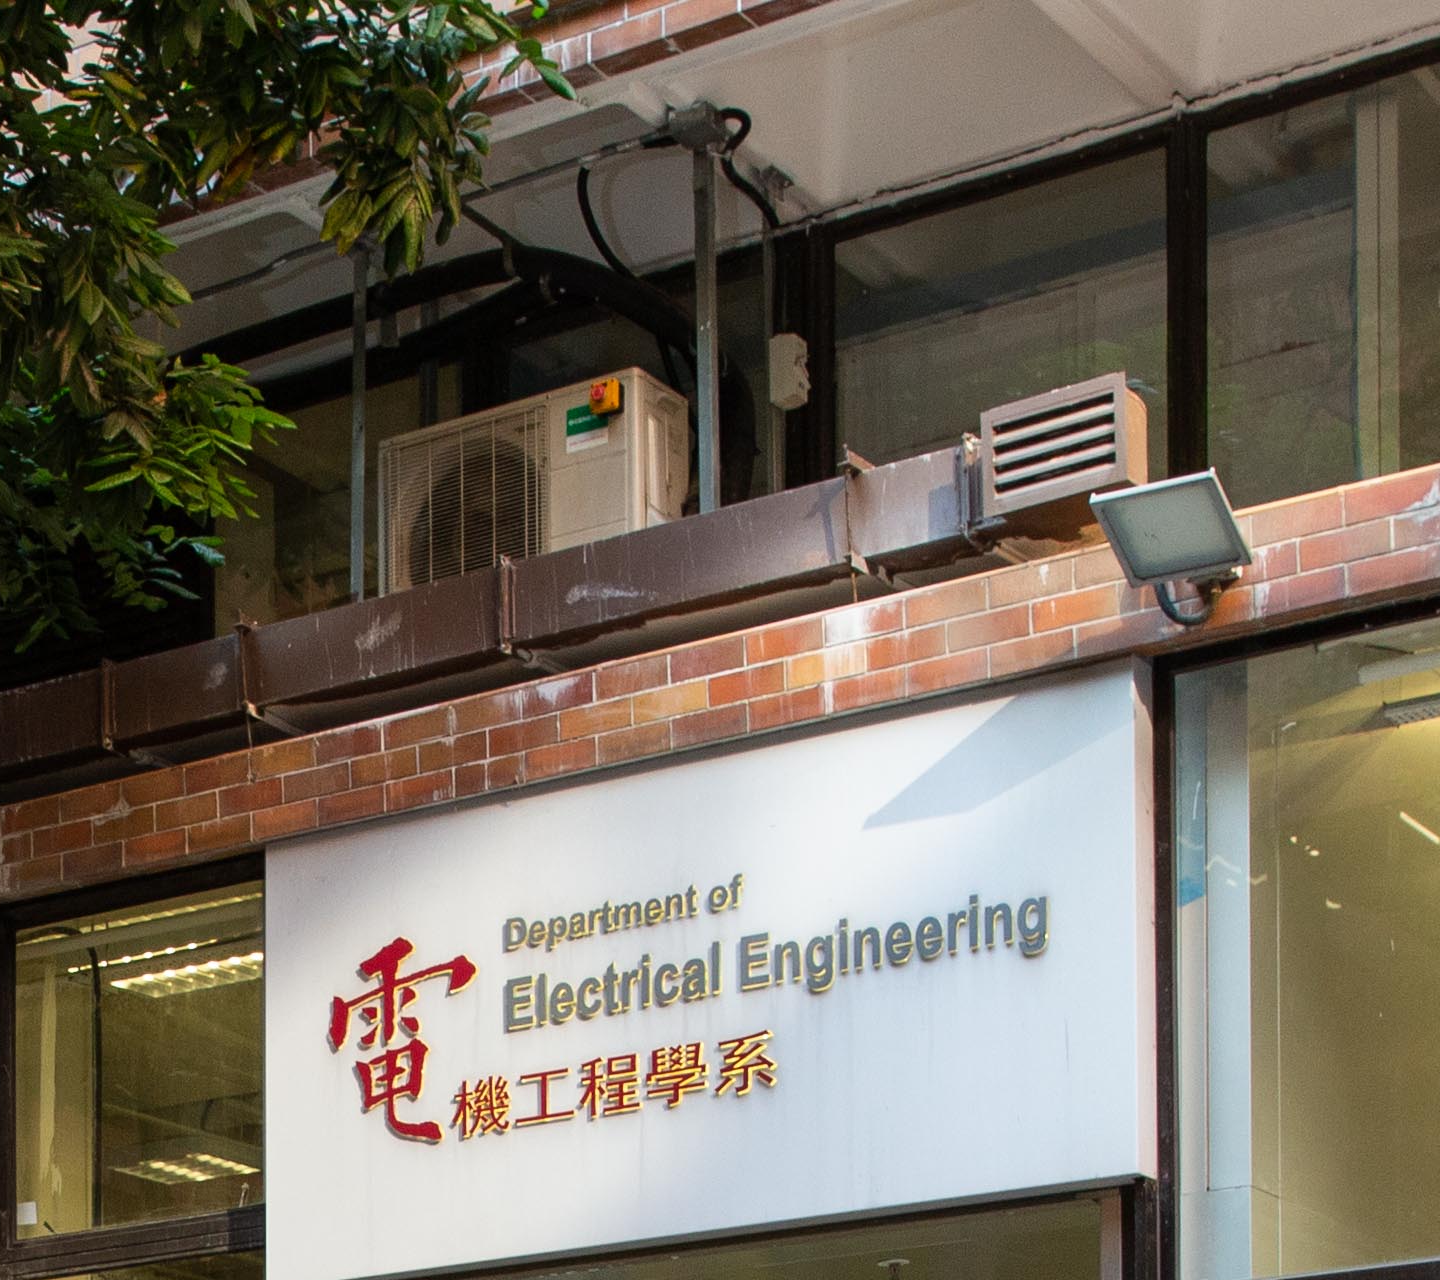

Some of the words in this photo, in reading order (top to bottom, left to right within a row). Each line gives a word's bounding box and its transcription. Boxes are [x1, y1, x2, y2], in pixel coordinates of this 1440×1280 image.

[502, 884, 698, 953] Department
[709, 873, 745, 914] of
[504, 941, 722, 1033] Electrical
[738, 894, 1051, 994] Engineering
